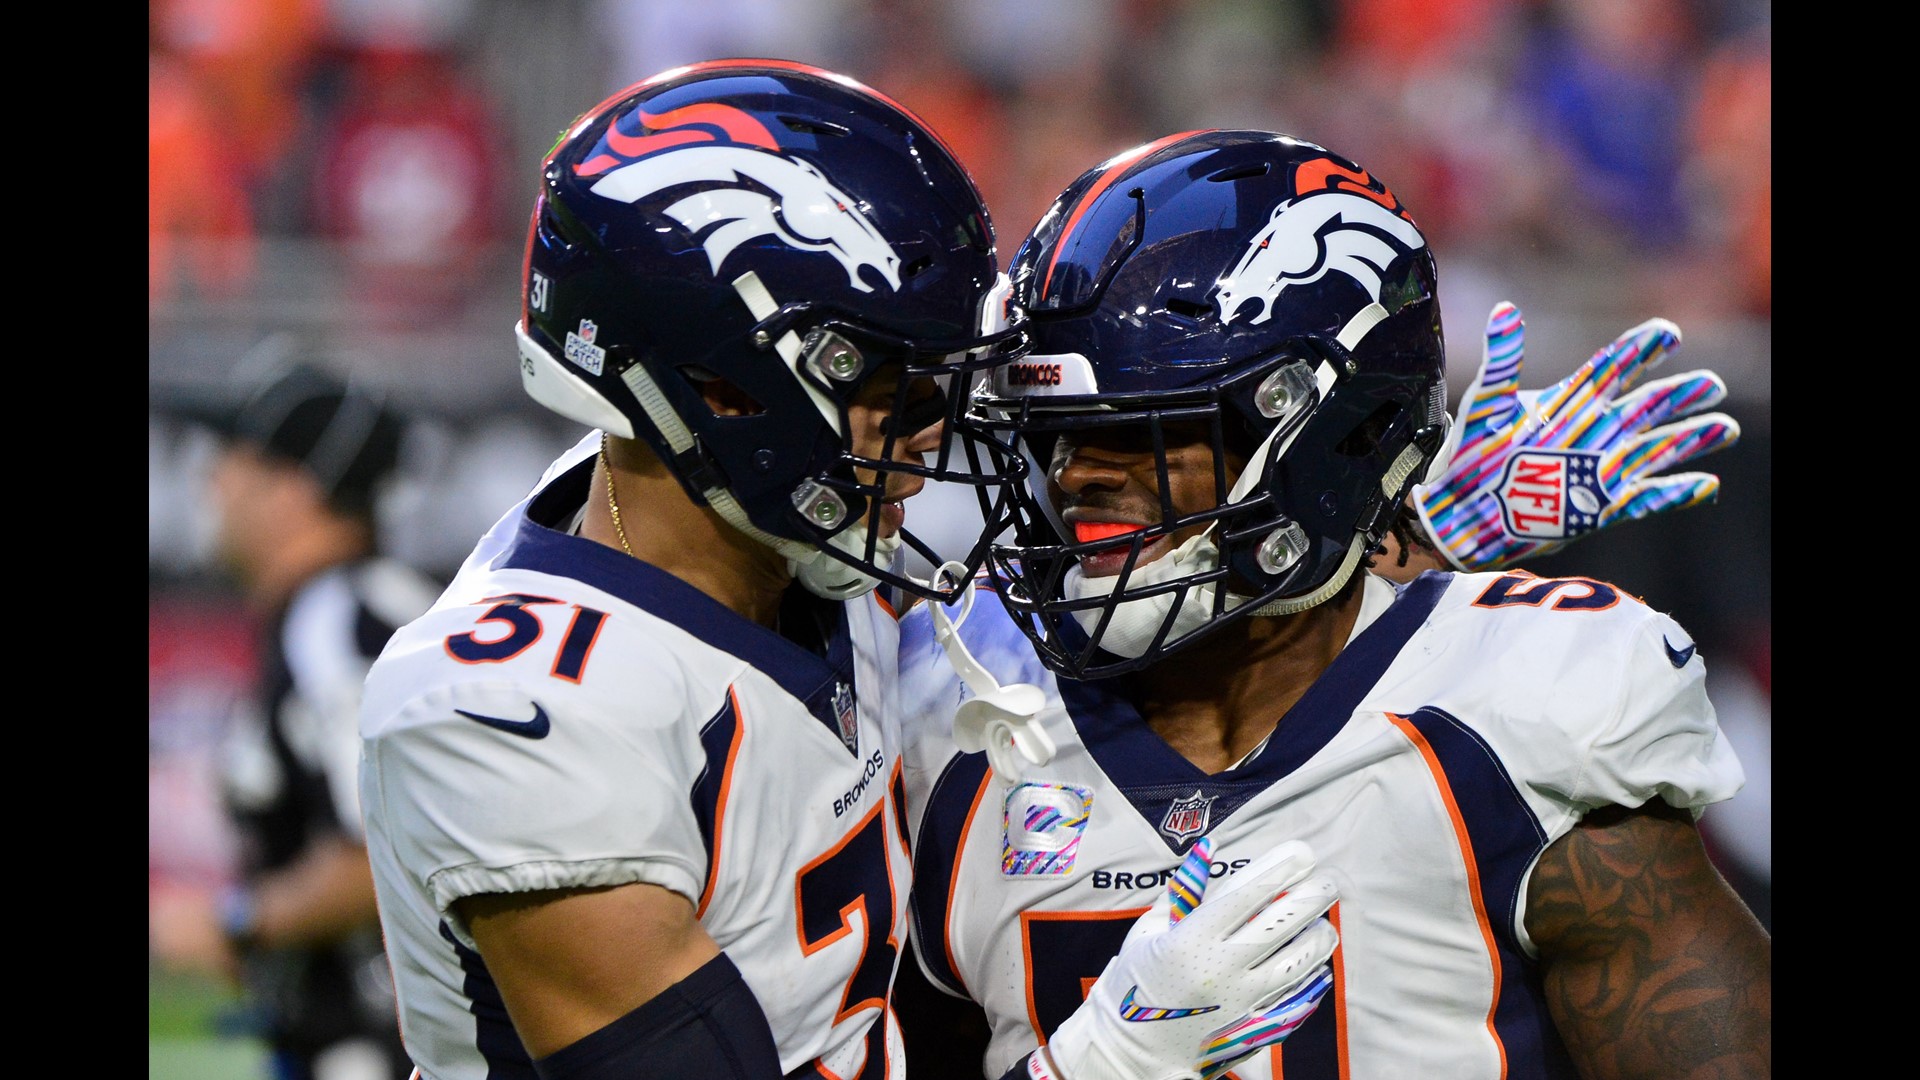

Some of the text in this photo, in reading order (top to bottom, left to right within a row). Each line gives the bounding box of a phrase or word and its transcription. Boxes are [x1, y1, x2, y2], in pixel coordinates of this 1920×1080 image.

[530, 273, 548, 312] 31
[566, 344, 601, 370] CATCH
[568, 335, 602, 358] CRUCIAL
[1007, 364, 1063, 386] BRONCOS
[1507, 460, 1563, 531] NFL
[443, 592, 612, 685] 31
[833, 749, 884, 818] BRONCOS
[1004, 786, 1086, 852] C
[1166, 810, 1200, 832] NFL
[1092, 858, 1251, 890] BRONOS
